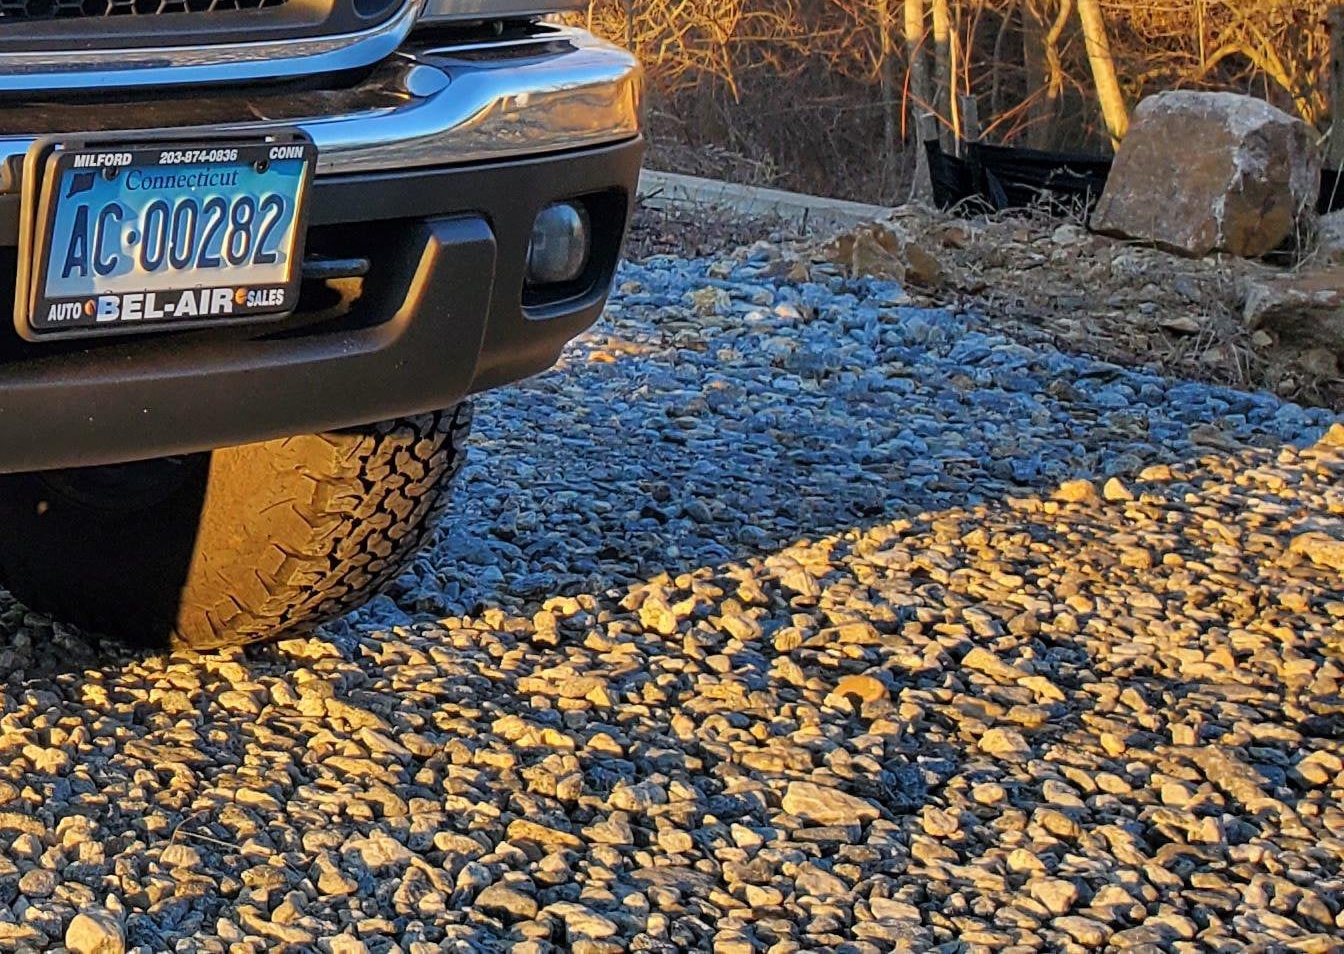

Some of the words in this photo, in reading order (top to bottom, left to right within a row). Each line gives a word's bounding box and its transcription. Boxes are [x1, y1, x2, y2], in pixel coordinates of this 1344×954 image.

[73, 153, 133, 168] MILFORD
[158, 149, 239, 165] 203-874-0836
[269, 146, 305, 160] CONN
[125, 167, 240, 191] Connecticut
[47, 303, 82, 322] AUTO
[95, 288, 233, 322] BEL-AIR
[246, 288, 285, 308] SALES
